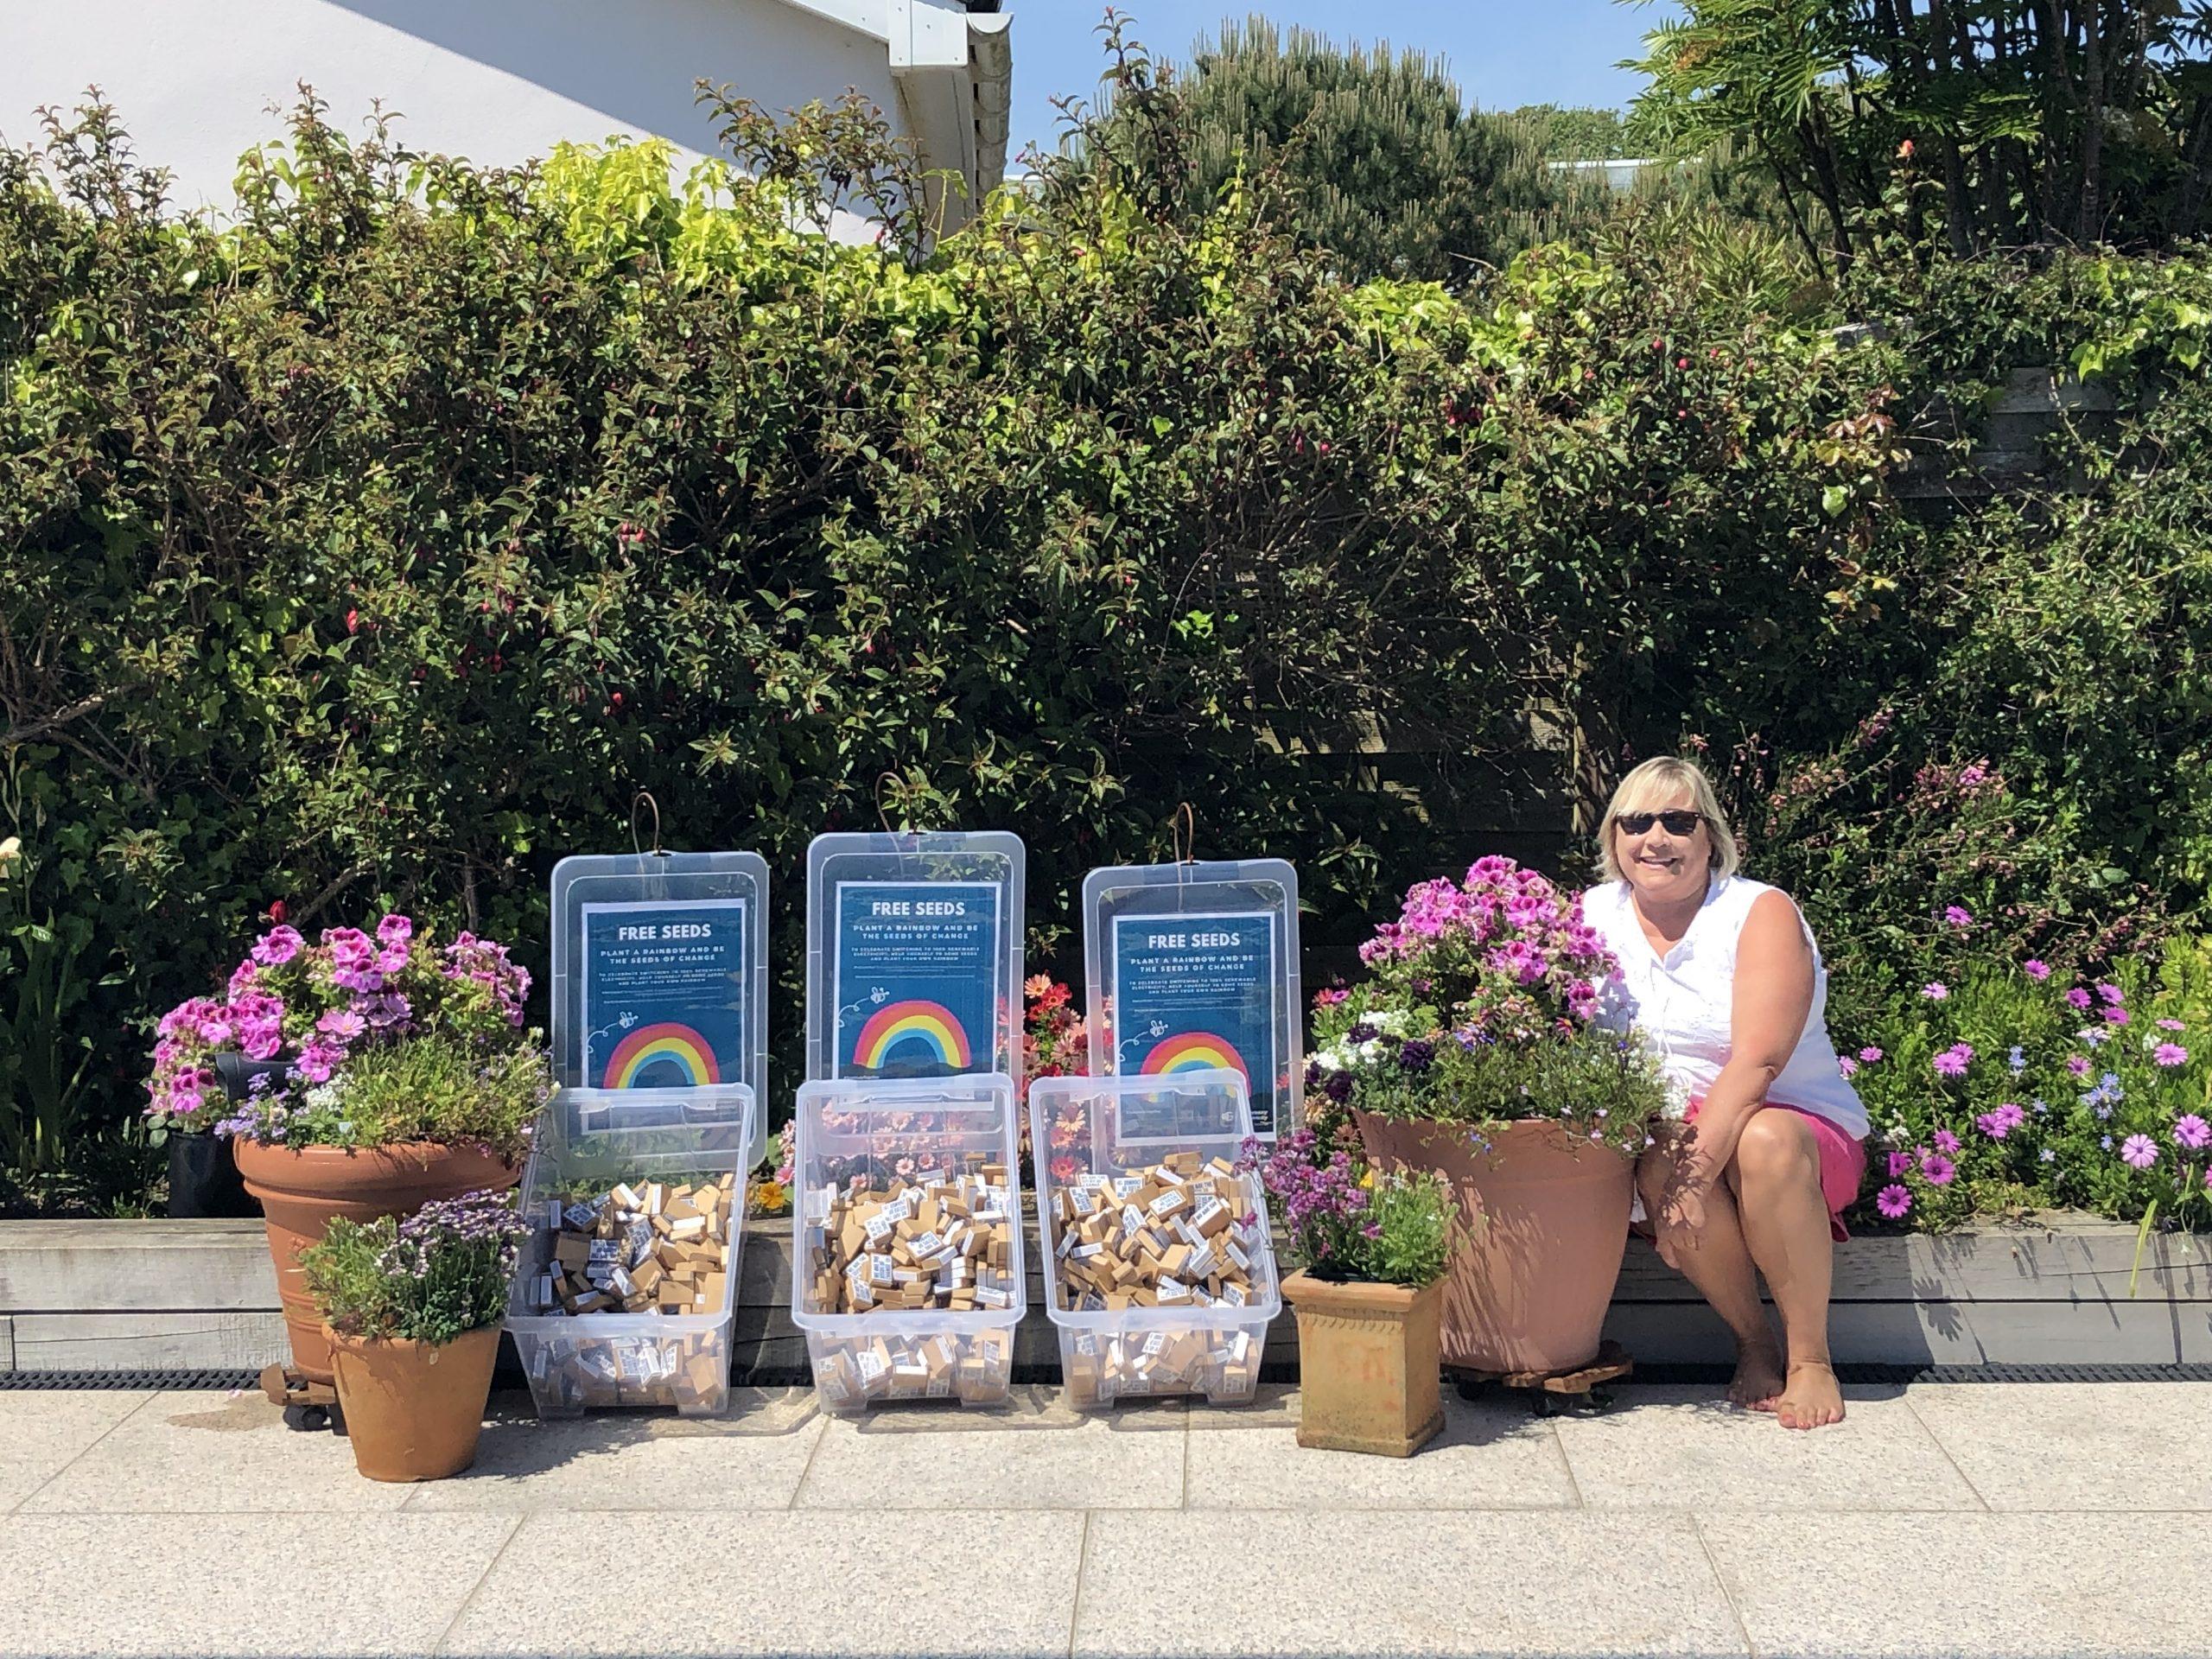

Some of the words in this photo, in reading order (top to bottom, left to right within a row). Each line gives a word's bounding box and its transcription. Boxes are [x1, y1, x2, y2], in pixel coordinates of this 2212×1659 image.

[872, 902, 910, 916] FREE
[915, 902, 965, 916] SEEDS
[619, 926, 657, 940] FREE
[662, 924, 712, 939] SEEDS
[1148, 934, 1186, 949] FREE
[1191, 932, 1241, 947] SEEDS
